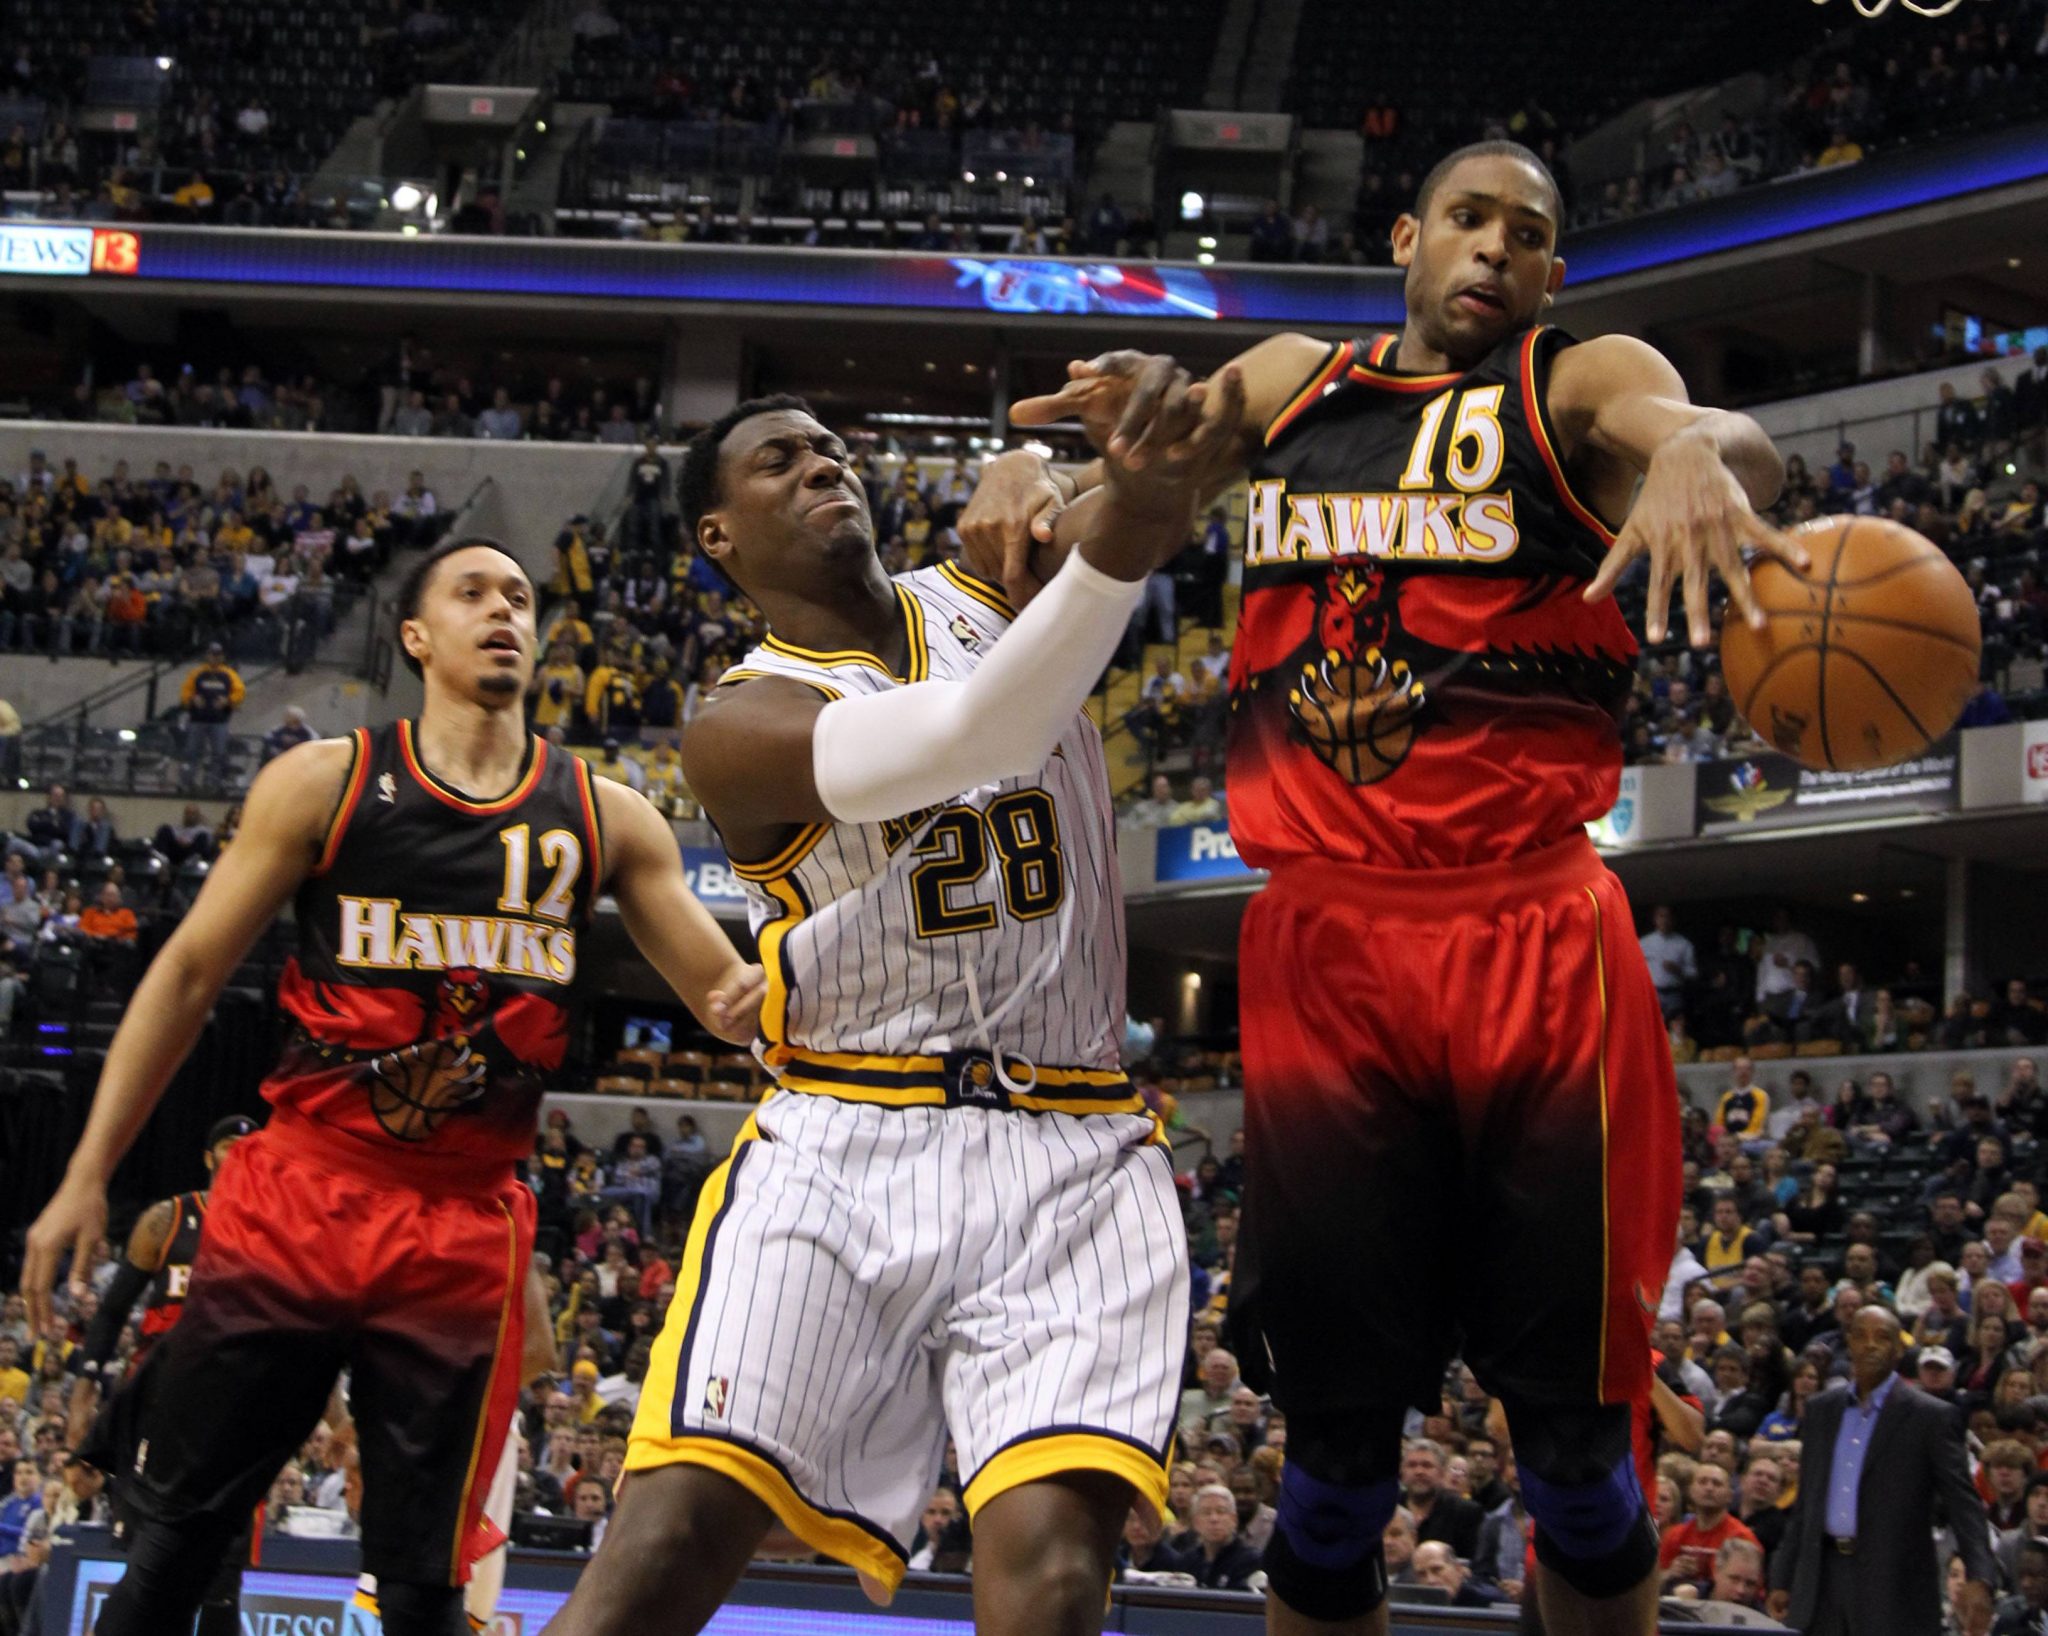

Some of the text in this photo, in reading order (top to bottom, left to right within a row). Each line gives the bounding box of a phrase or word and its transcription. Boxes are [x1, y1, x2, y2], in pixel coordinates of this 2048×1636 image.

[0, 232, 138, 271] EWS 13
[1399, 385, 1505, 492] 15
[1246, 478, 1519, 567] HAWKS
[497, 823, 583, 924] 12
[910, 787, 1065, 939] 28
[336, 894, 576, 986] HAWKS
